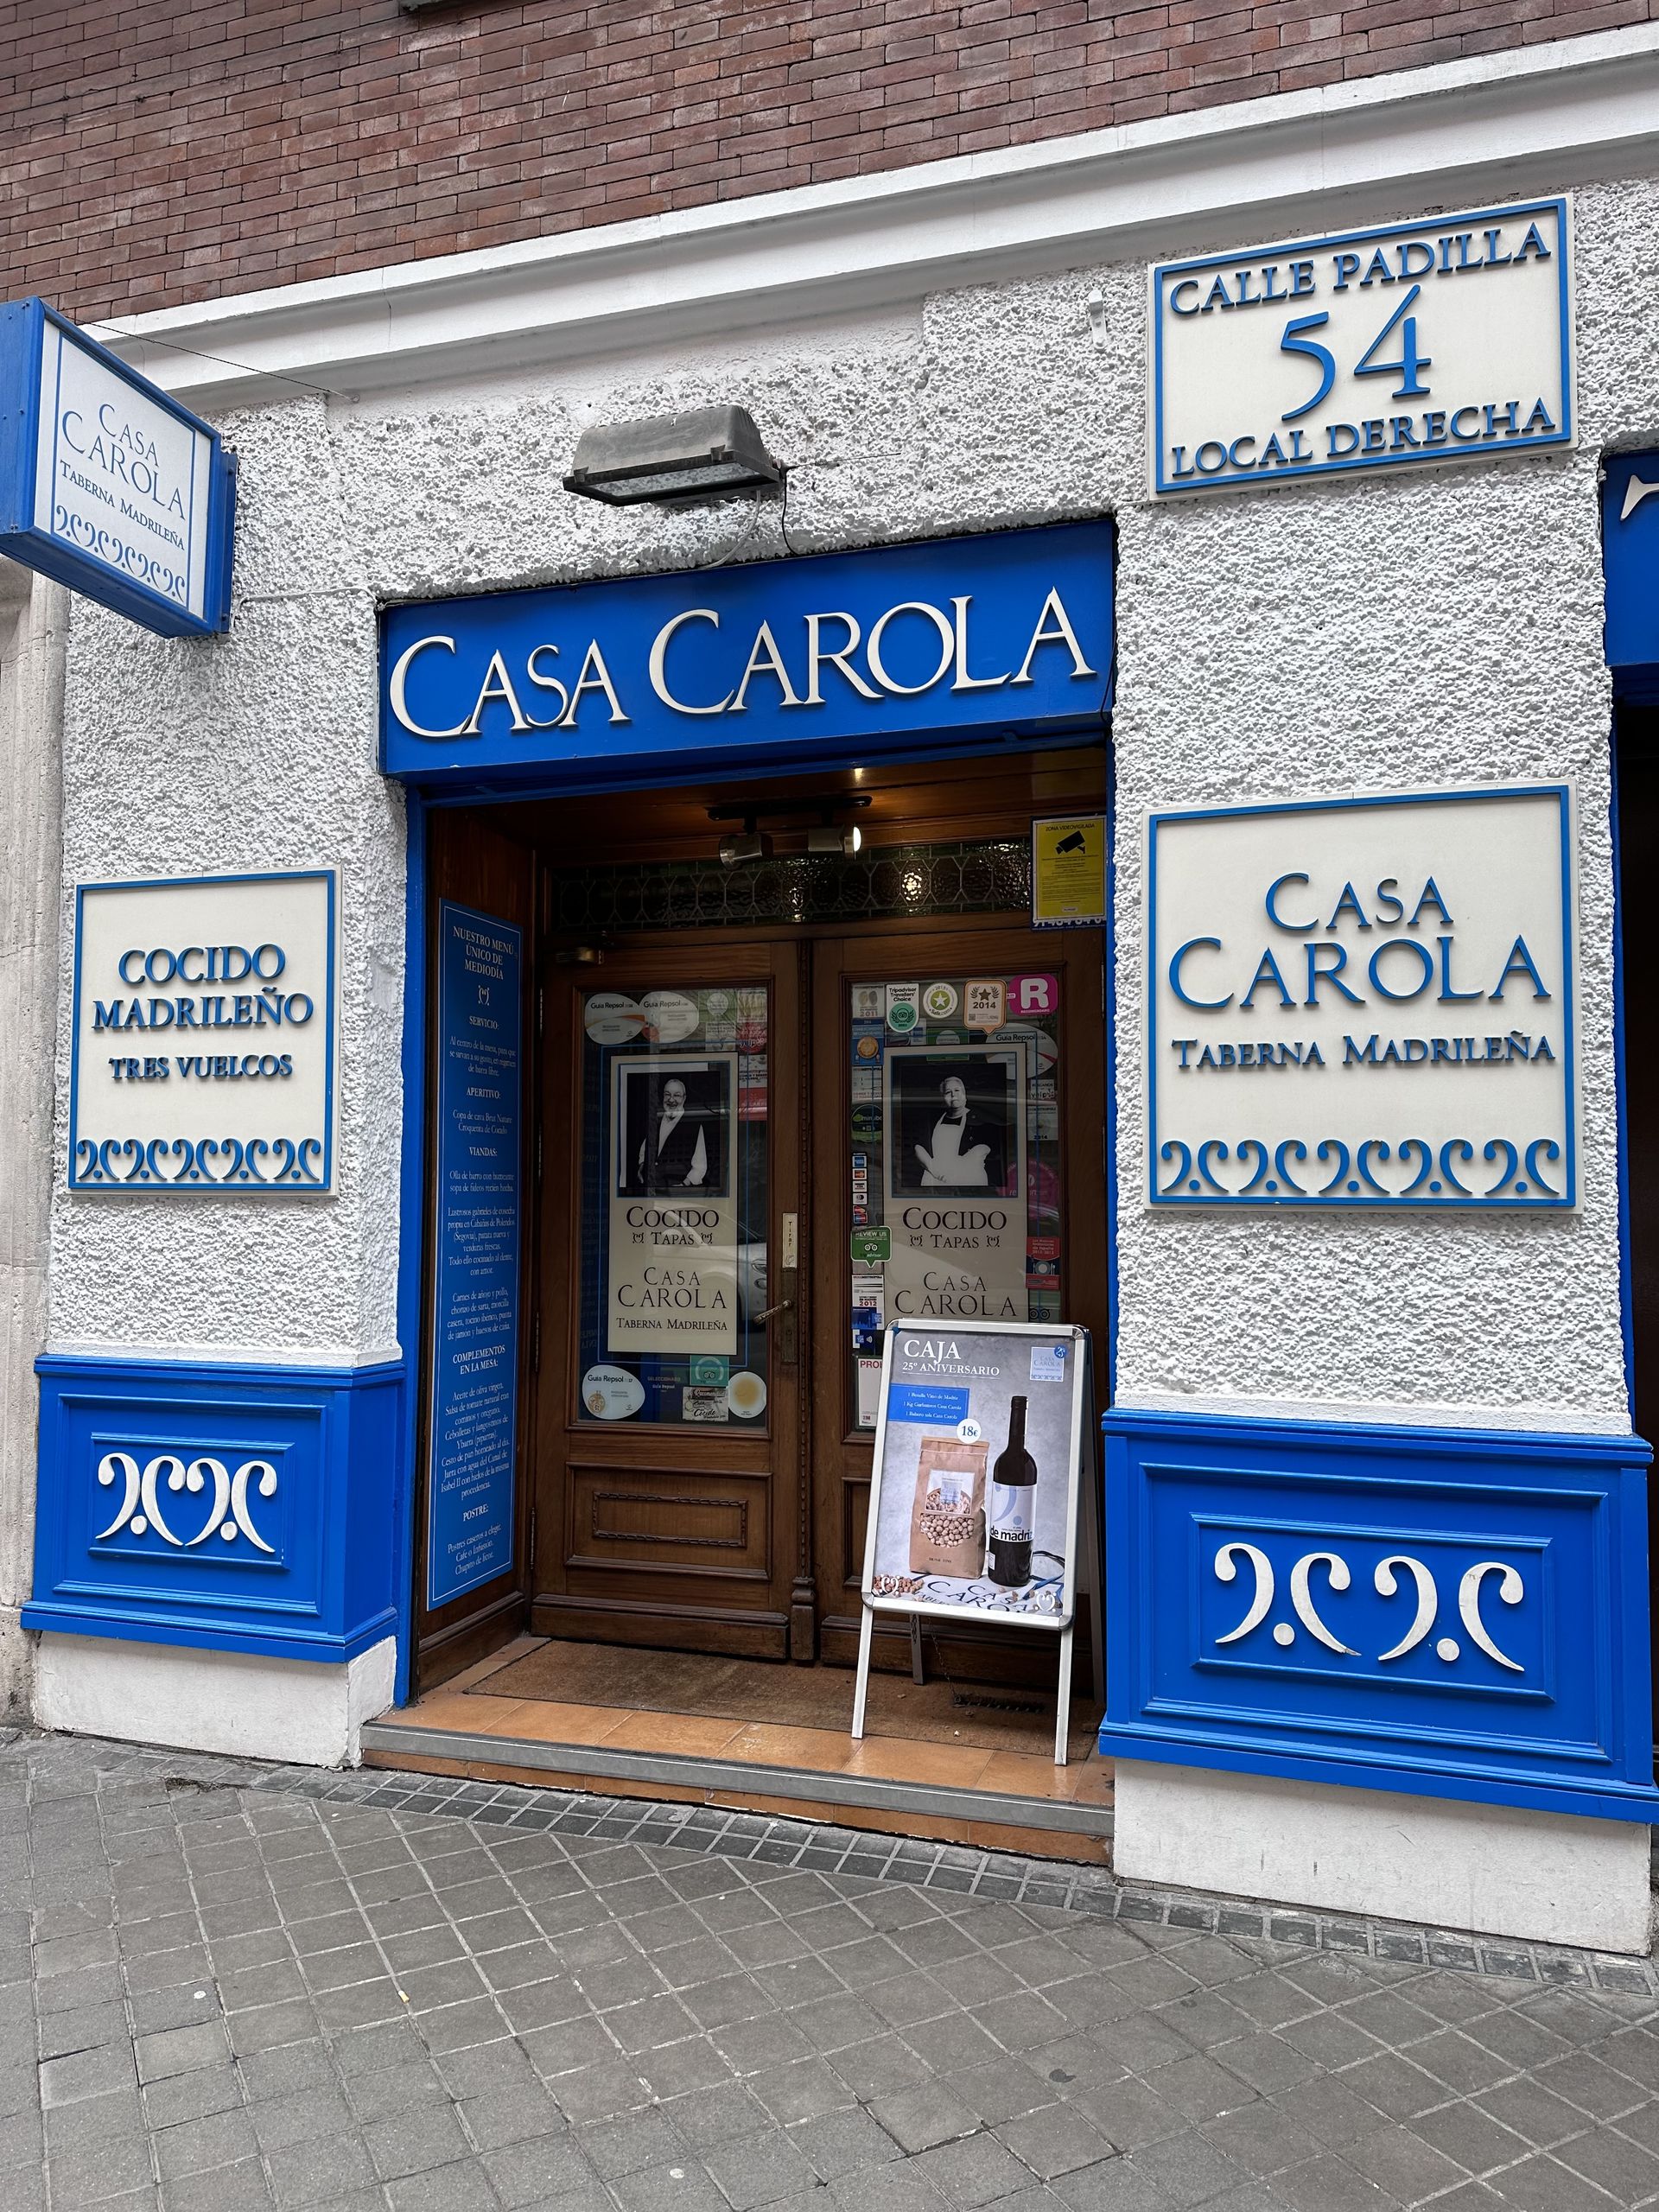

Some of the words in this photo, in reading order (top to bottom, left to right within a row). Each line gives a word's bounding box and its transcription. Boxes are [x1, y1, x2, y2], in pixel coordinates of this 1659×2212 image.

[1170, 260, 1315, 315] CALLE
[1333, 222, 1551, 290] PADILLA
[1281, 284, 1432, 422] 54
[99, 404, 159, 467] CASA
[1172, 430, 1313, 477] LOCAL
[1326, 397, 1555, 457] DERECHA
[62, 411, 186, 521] CAROLA
[60, 460, 115, 508] TABERNA
[120, 498, 185, 550] MADRILEÑA
[390, 635, 631, 737] CASA
[649, 586, 1097, 715] CAROLA
[1265, 873, 1453, 931] CASA
[453, 926, 490, 948] NUESTRO
[492, 936, 513, 956] MENÚ
[118, 944, 286, 984] COCIDO
[465, 942, 491, 962] ÚNICO
[493, 953, 503, 966] DE
[464, 956, 503, 980] MEDIODÍA
[1168, 935, 1551, 1008] CAROLA
[1020, 978, 1049, 1009] R
[92, 987, 314, 1029] MADRILEÑO
[1172, 1039, 1325, 1068] TABERNA
[1342, 1031, 1555, 1065] MADRILEÑA
[109, 1056, 170, 1079] TRES
[175, 1054, 293, 1077] VUELCOS
[626, 1206, 720, 1228] COCIDO
[903, 1207, 1007, 1230] COCIDO
[651, 1231, 695, 1245] TAPAS
[931, 1234, 980, 1249] TAPAS
[644, 1267, 701, 1286] CASA
[924, 1272, 987, 1291] CASA
[618, 1285, 727, 1309] CAROLA
[895, 1291, 1017, 1316] CAROLA
[616, 1318, 662, 1330] TABERNA
[667, 1319, 728, 1331] MADRILEÑA
[452, 1344, 505, 1364] COMPLEMENTOS
[904, 1339, 961, 1365] CAJA
[460, 1363, 469, 1375] EN
[471, 1362, 479, 1372] LA
[860, 1360, 882, 1369] PRO
[919, 1363, 1001, 1376] ANIVERSARIO
[962, 1426, 978, 1437] 18€
[462, 1502, 488, 1522] POSTRE:
[990, 1526, 999, 1538] de
